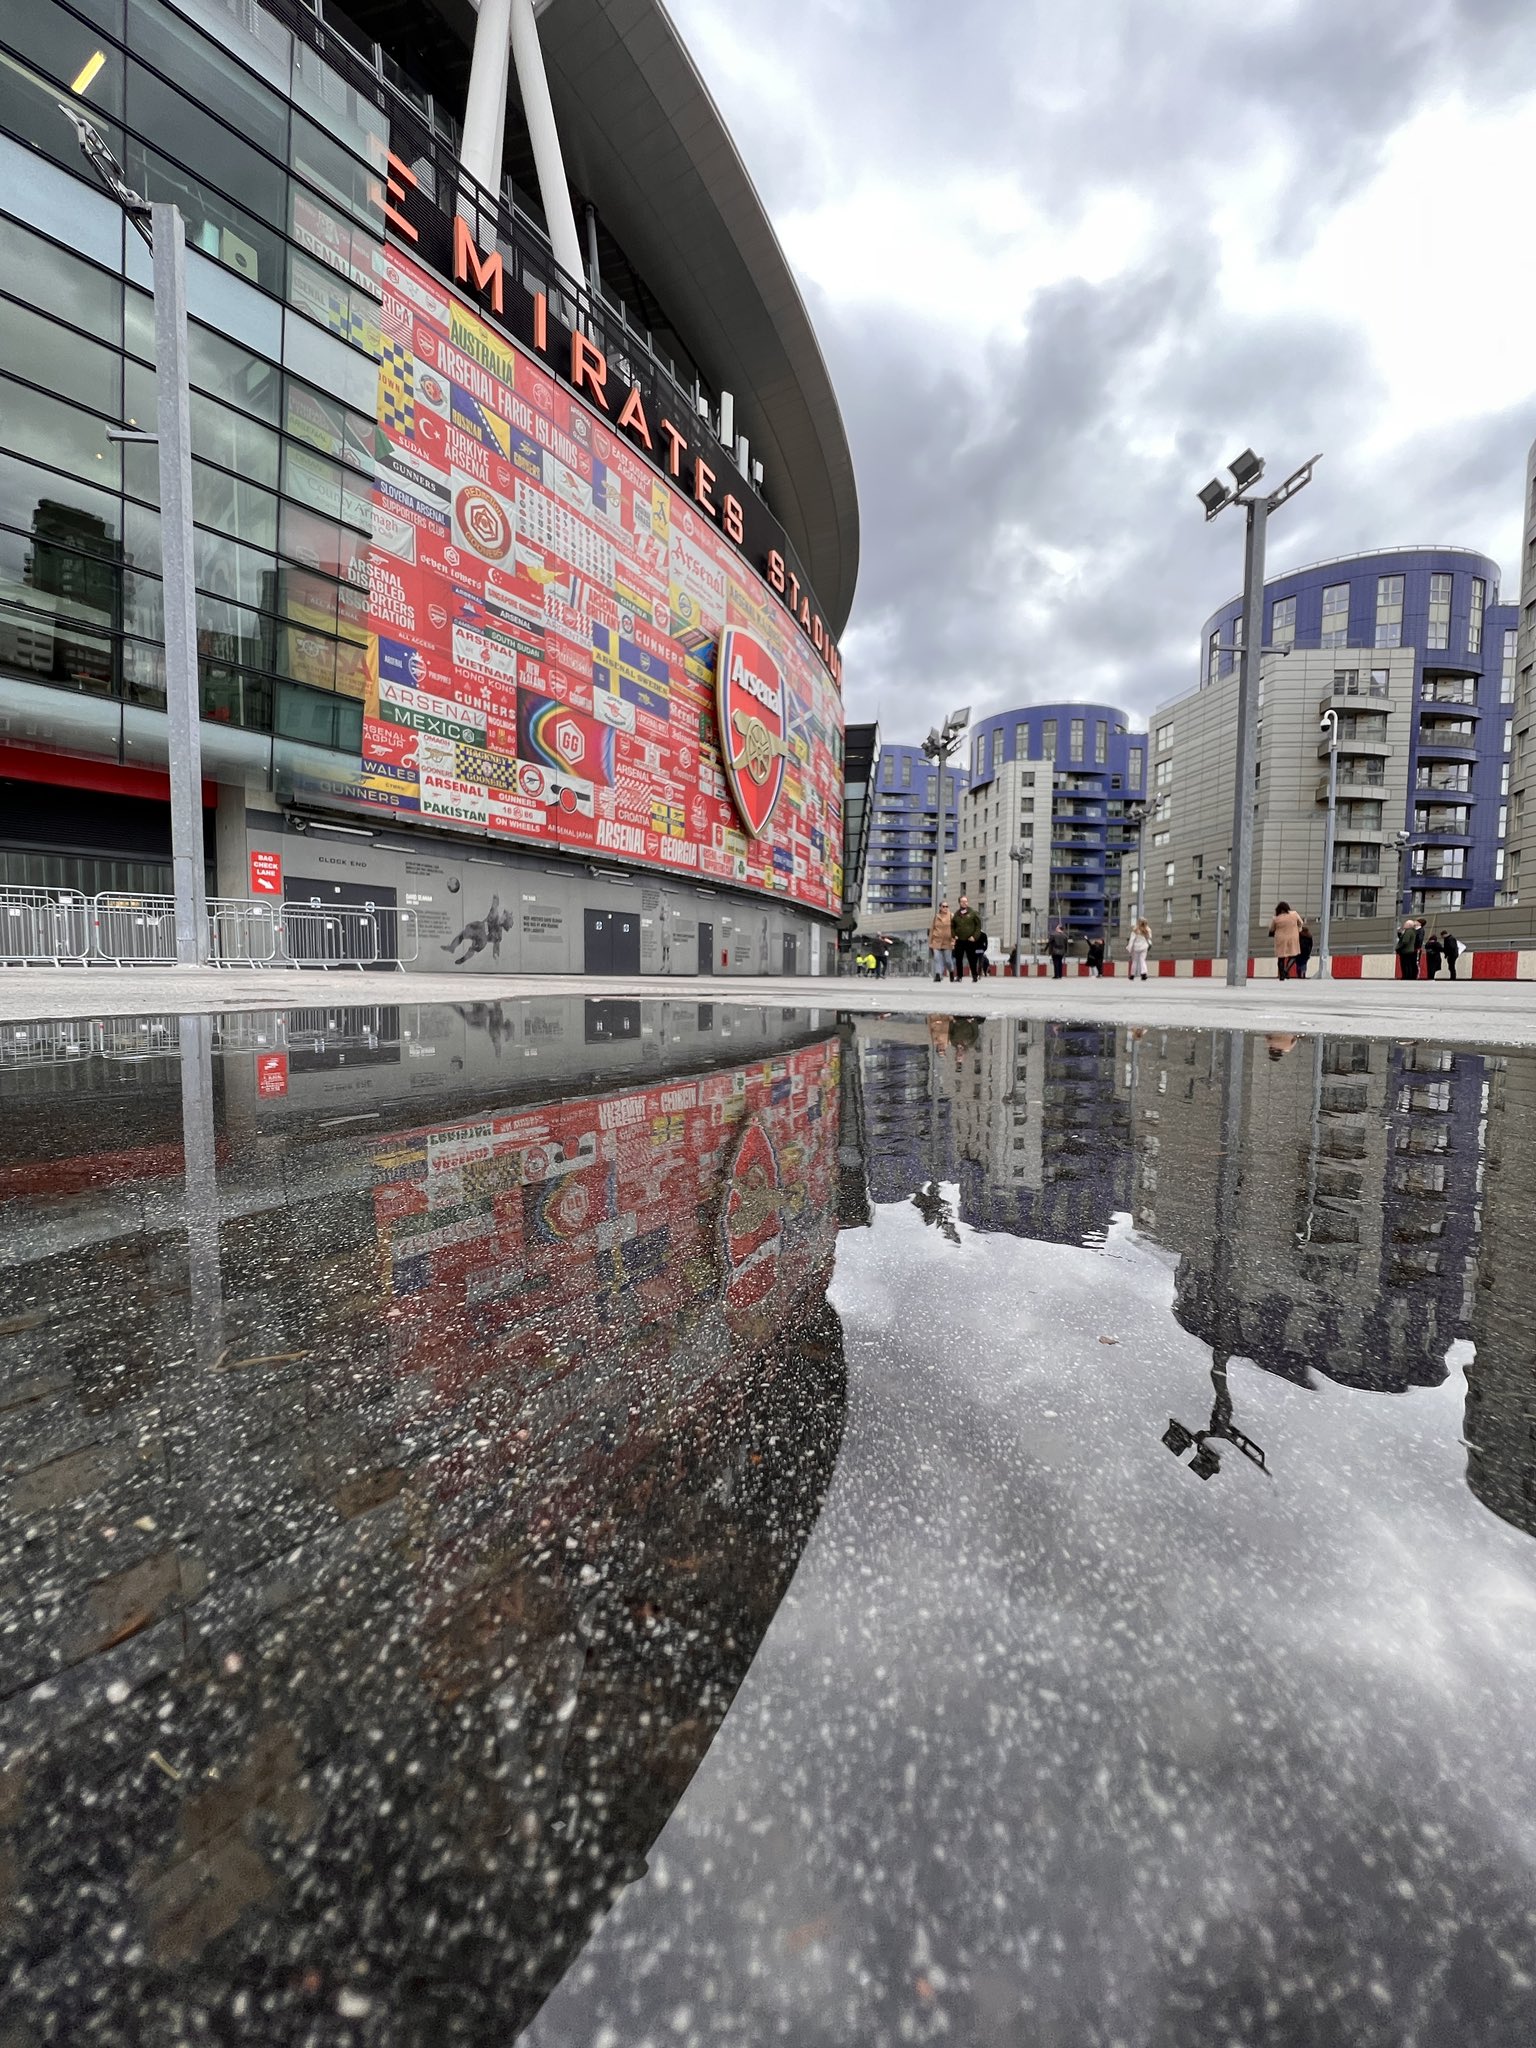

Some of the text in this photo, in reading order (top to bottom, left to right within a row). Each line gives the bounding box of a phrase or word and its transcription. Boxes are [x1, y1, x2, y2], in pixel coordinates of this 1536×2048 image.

[451, 319, 514, 389] AUSTRALIA
[367, 131, 842, 687] EMIRATES STADIUM
[437, 341, 496, 408] ARSENAL
[498, 386, 534, 435] FAROE
[535, 415, 578, 469] ISLANDS
[398, 436, 430, 460] SUDAN
[392, 461, 437, 492] GUNNERS
[444, 442, 492, 486] ARSENAL
[354, 501, 400, 534] Armagh
[380, 481, 446, 526] SLOVENIA ARSENAL
[381, 496, 445, 538] SUPPORTERS CLUB
[349, 556, 405, 591] ARSENAL
[671, 535, 725, 598] Arsenal
[347, 568, 406, 602] DISABLED
[338, 588, 416, 632] ASSOCIATION
[499, 609, 532, 631] ARSENAL
[620, 597, 649, 619] GHANA
[398, 631, 437, 651] ALL ACCESS
[456, 627, 515, 659] ARSENAL
[491, 631, 541, 658] SOUTH SUDAN
[454, 666, 516, 696] HONG KONG
[456, 654, 515, 685] VIETNAM
[595, 650, 637, 680] ARSENAL
[637, 674, 668, 696] SWEDEN
[731, 653, 783, 718] Arsenal
[384, 685, 484, 727] ARSENAL
[454, 690, 517, 720] GUNNERS
[394, 707, 461, 740] MEXICO
[464, 745, 510, 765] HACKNEY
[562, 731, 580, 754] GG
[363, 760, 417, 781] WALES
[616, 762, 652, 783] ARSENAL
[320, 780, 400, 805] GUNNERS
[425, 775, 485, 798] ARSENAL
[498, 792, 537, 808] GUNNERS
[423, 800, 487, 822] PAKISTAN
[495, 817, 540, 833] ON WHEELS
[618, 809, 651, 827] CROATIA
[547, 823, 594, 841] ARSENAL JAPAN
[596, 818, 647, 856] ARSENAL
[660, 835, 698, 867] GEORGIA
[253, 861, 279, 870] CHECK
[256, 868, 276, 877] LANE
[257, 854, 274, 862] BAG
[318, 856, 368, 869] CLOCK END
